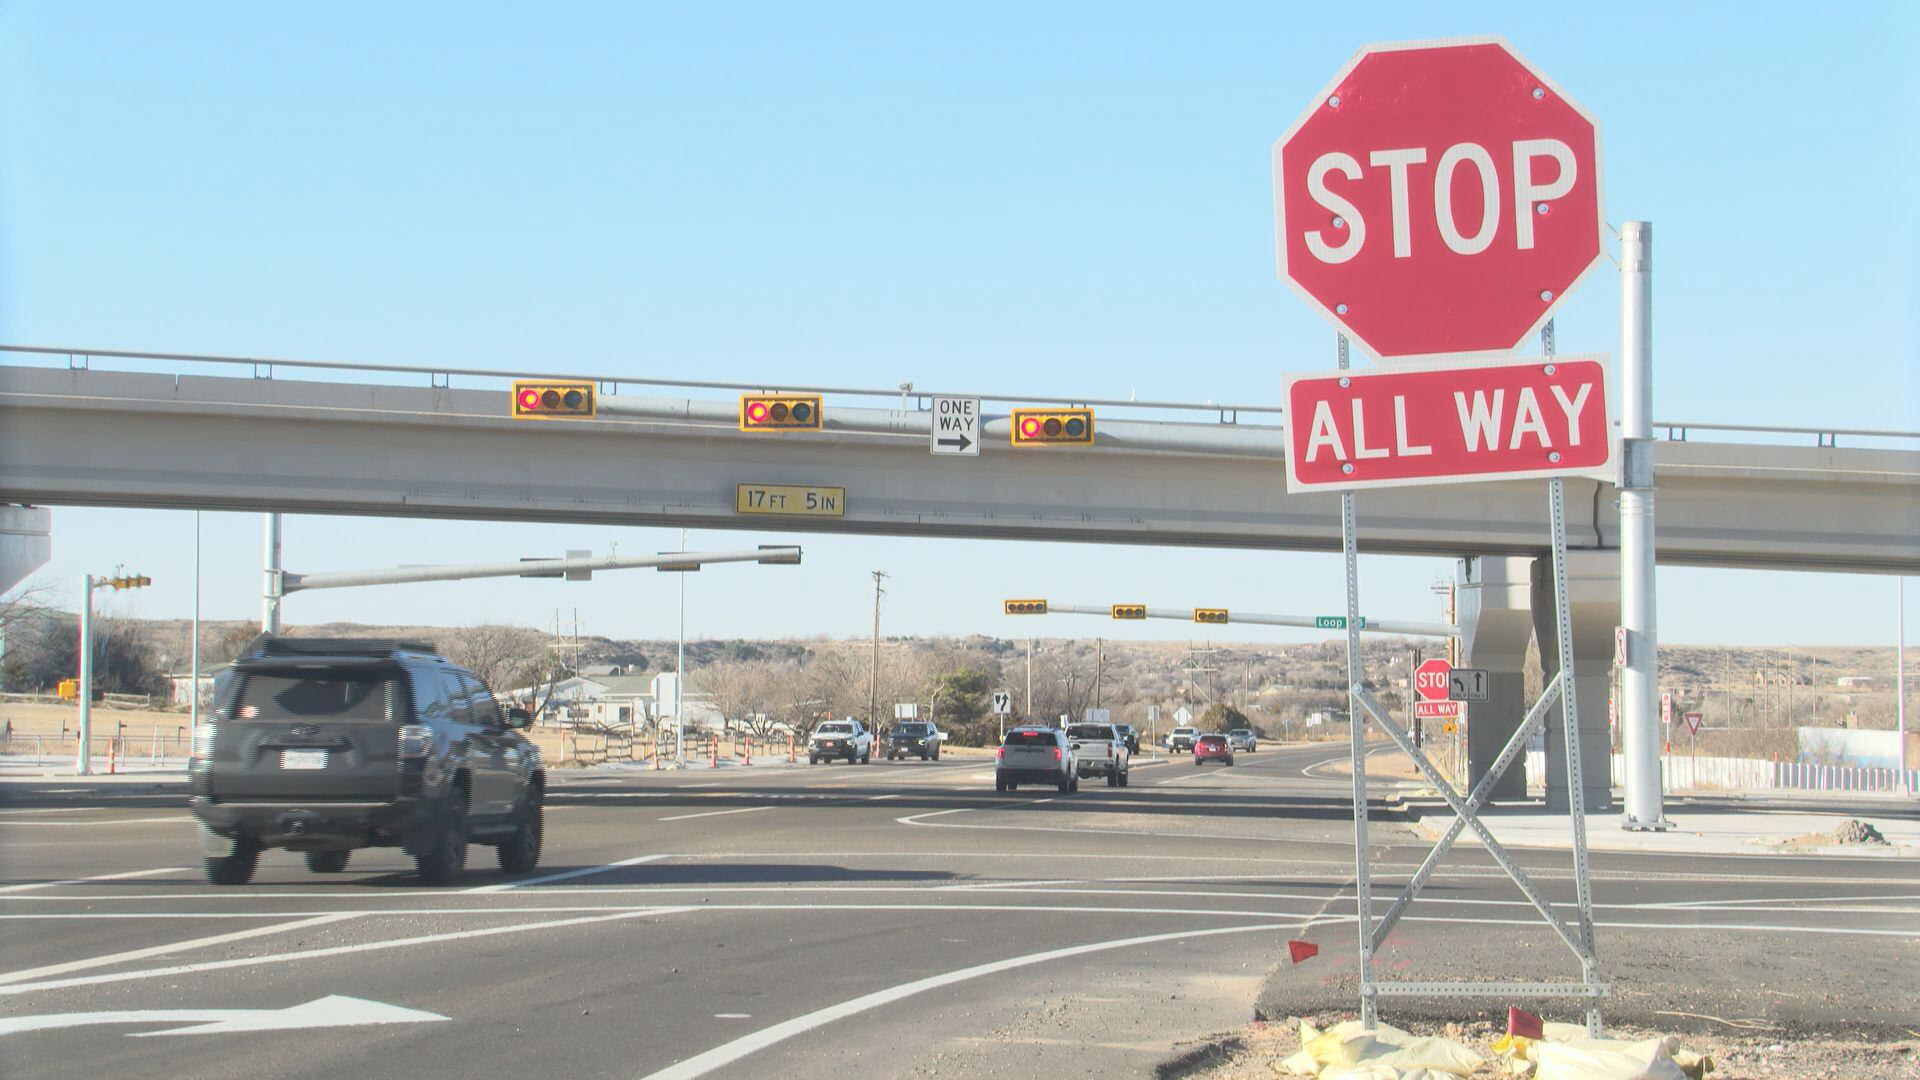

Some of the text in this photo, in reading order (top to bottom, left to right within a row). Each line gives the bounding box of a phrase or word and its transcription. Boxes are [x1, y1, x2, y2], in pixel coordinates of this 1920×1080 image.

[1304, 138, 1577, 264] STOP
[940, 400, 972, 415] ONE
[939, 416, 974, 431] WAY
[1305, 383, 1593, 463] ALL WAY
[1318, 618, 1342, 629] Loop
[1418, 672, 1448, 688] STO
[1418, 703, 1456, 714] ALL WAY
